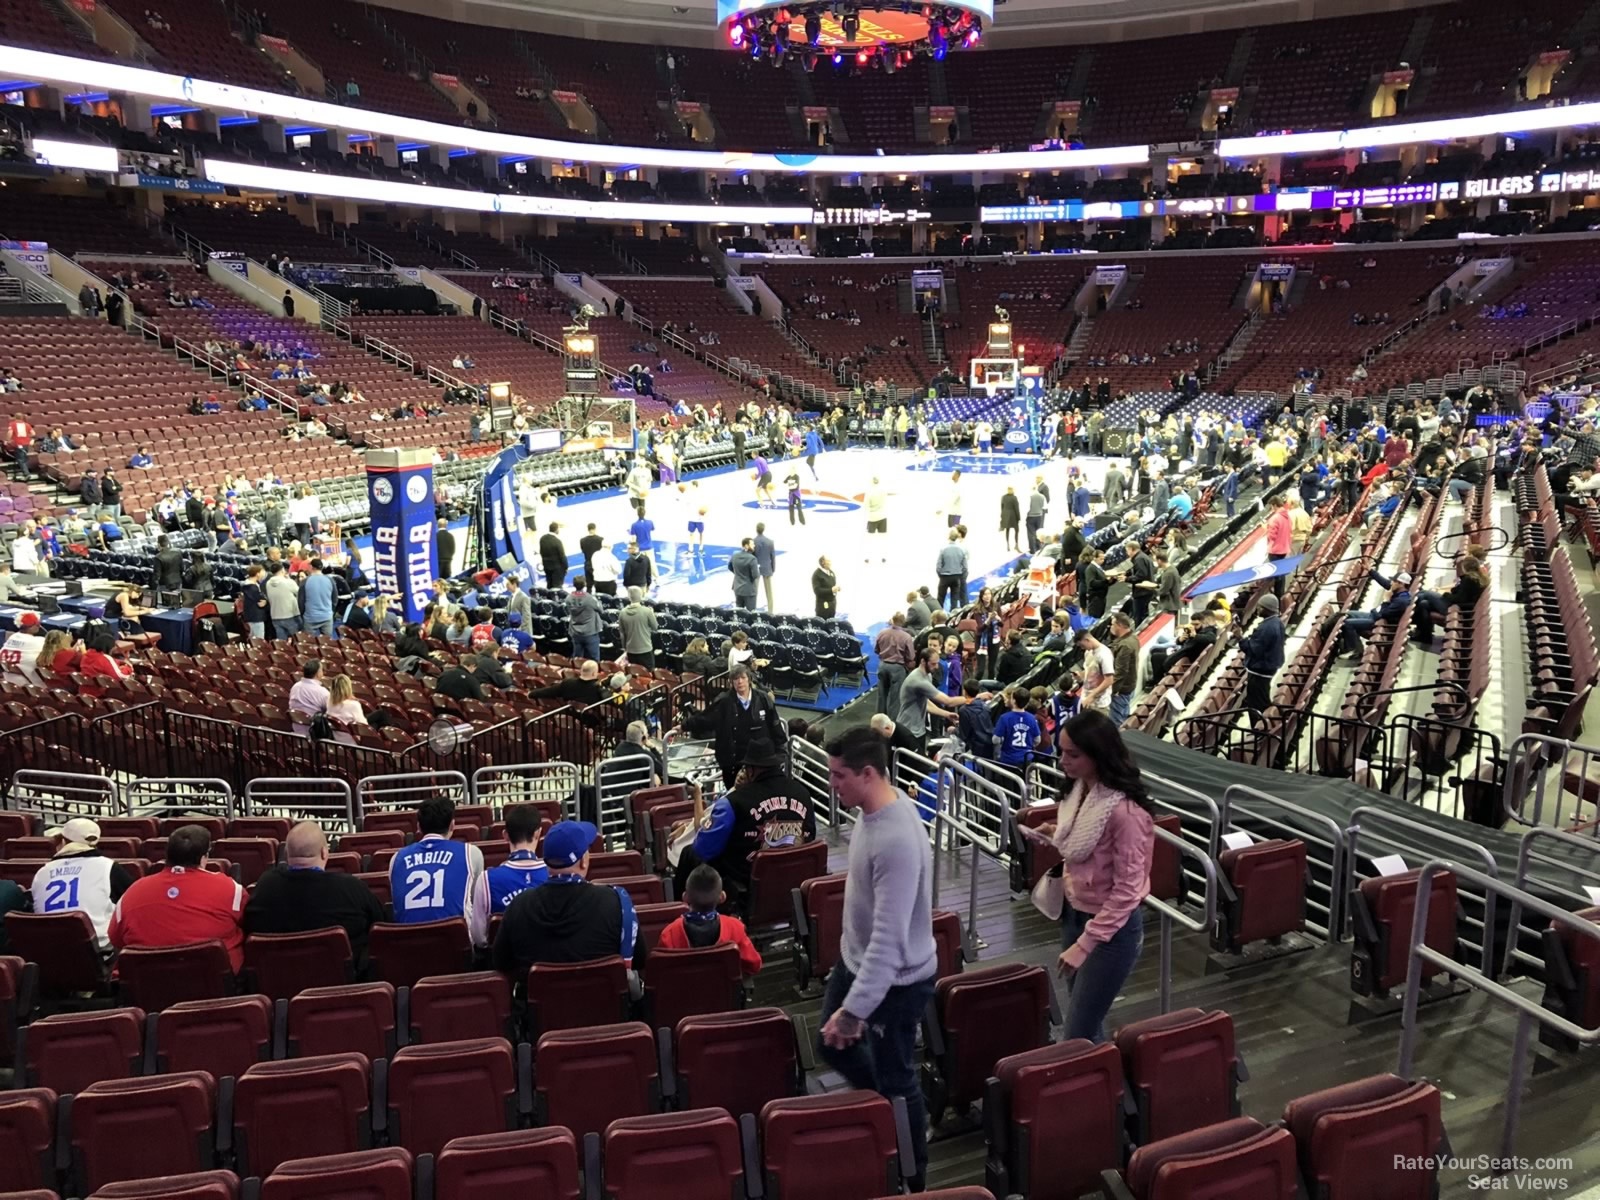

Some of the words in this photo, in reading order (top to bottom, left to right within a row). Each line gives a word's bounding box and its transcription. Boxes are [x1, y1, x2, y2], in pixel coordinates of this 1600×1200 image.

[174, 179, 190, 189] IGS
[408, 521, 432, 611] PHILA
[1011, 731, 1027, 747] 21
[403, 850, 453, 870] EMBIID
[44, 877, 80, 913] 21
[404, 869, 445, 910] 21
